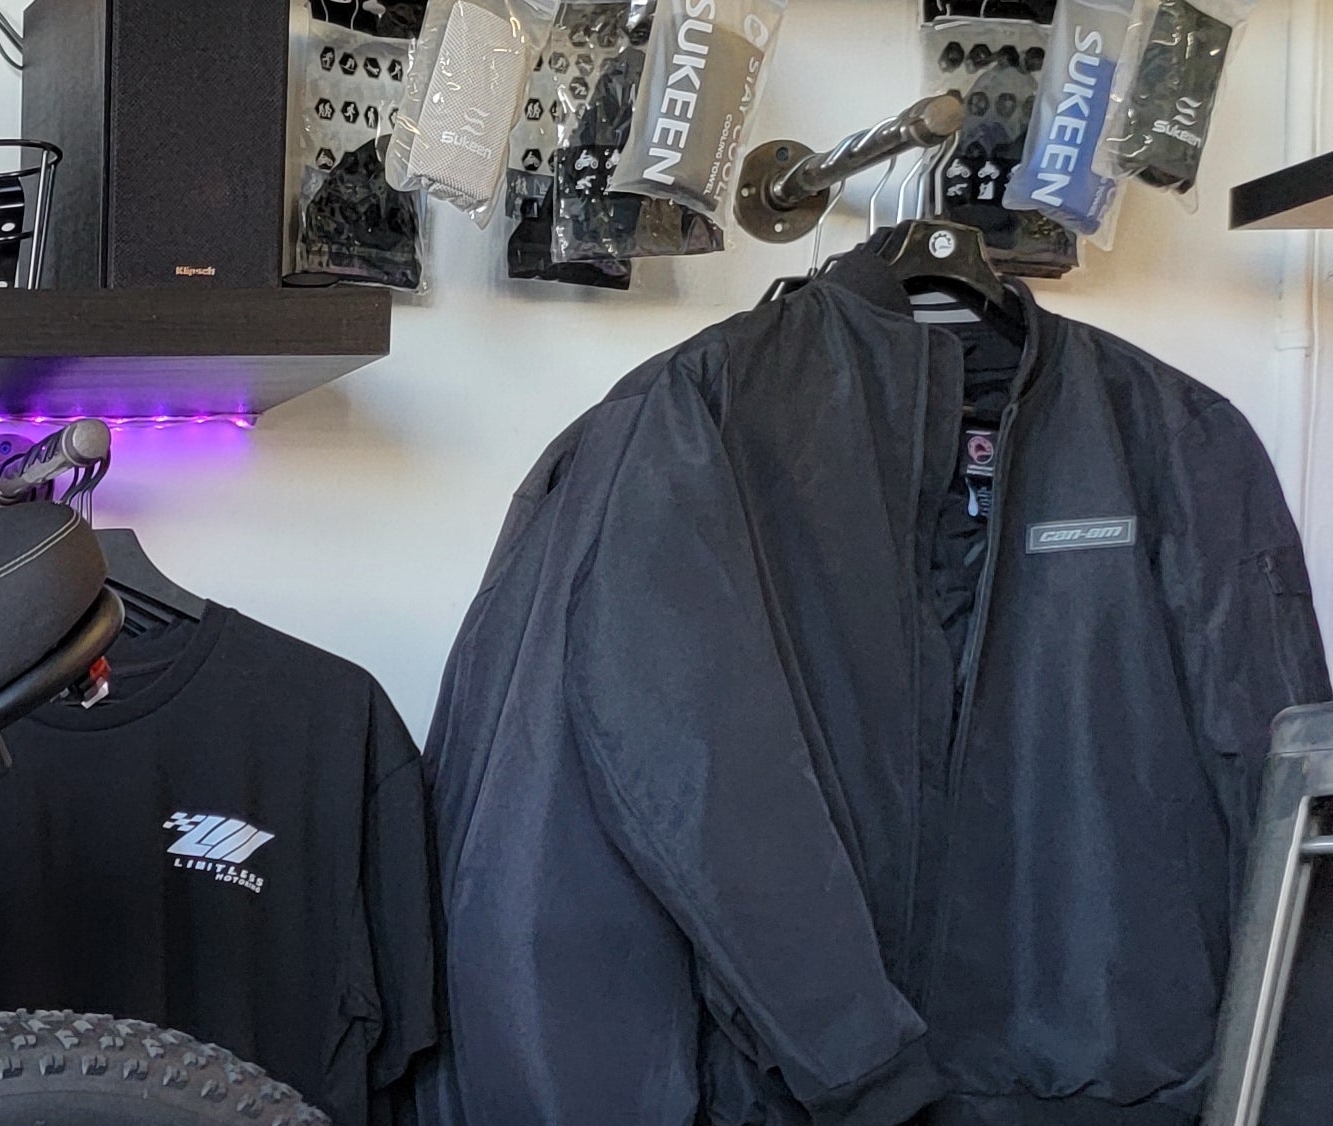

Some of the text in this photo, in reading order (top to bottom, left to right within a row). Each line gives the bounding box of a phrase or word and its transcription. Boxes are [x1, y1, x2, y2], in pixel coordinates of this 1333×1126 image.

[642, 0, 717, 186] SUKEEN
[1030, 25, 1103, 207] SUKEEN
[703, 113, 733, 196] COOLING TOWEL
[175, 266, 215, 276] Klipsch
[174, 858, 264, 887] LIMITLESS
